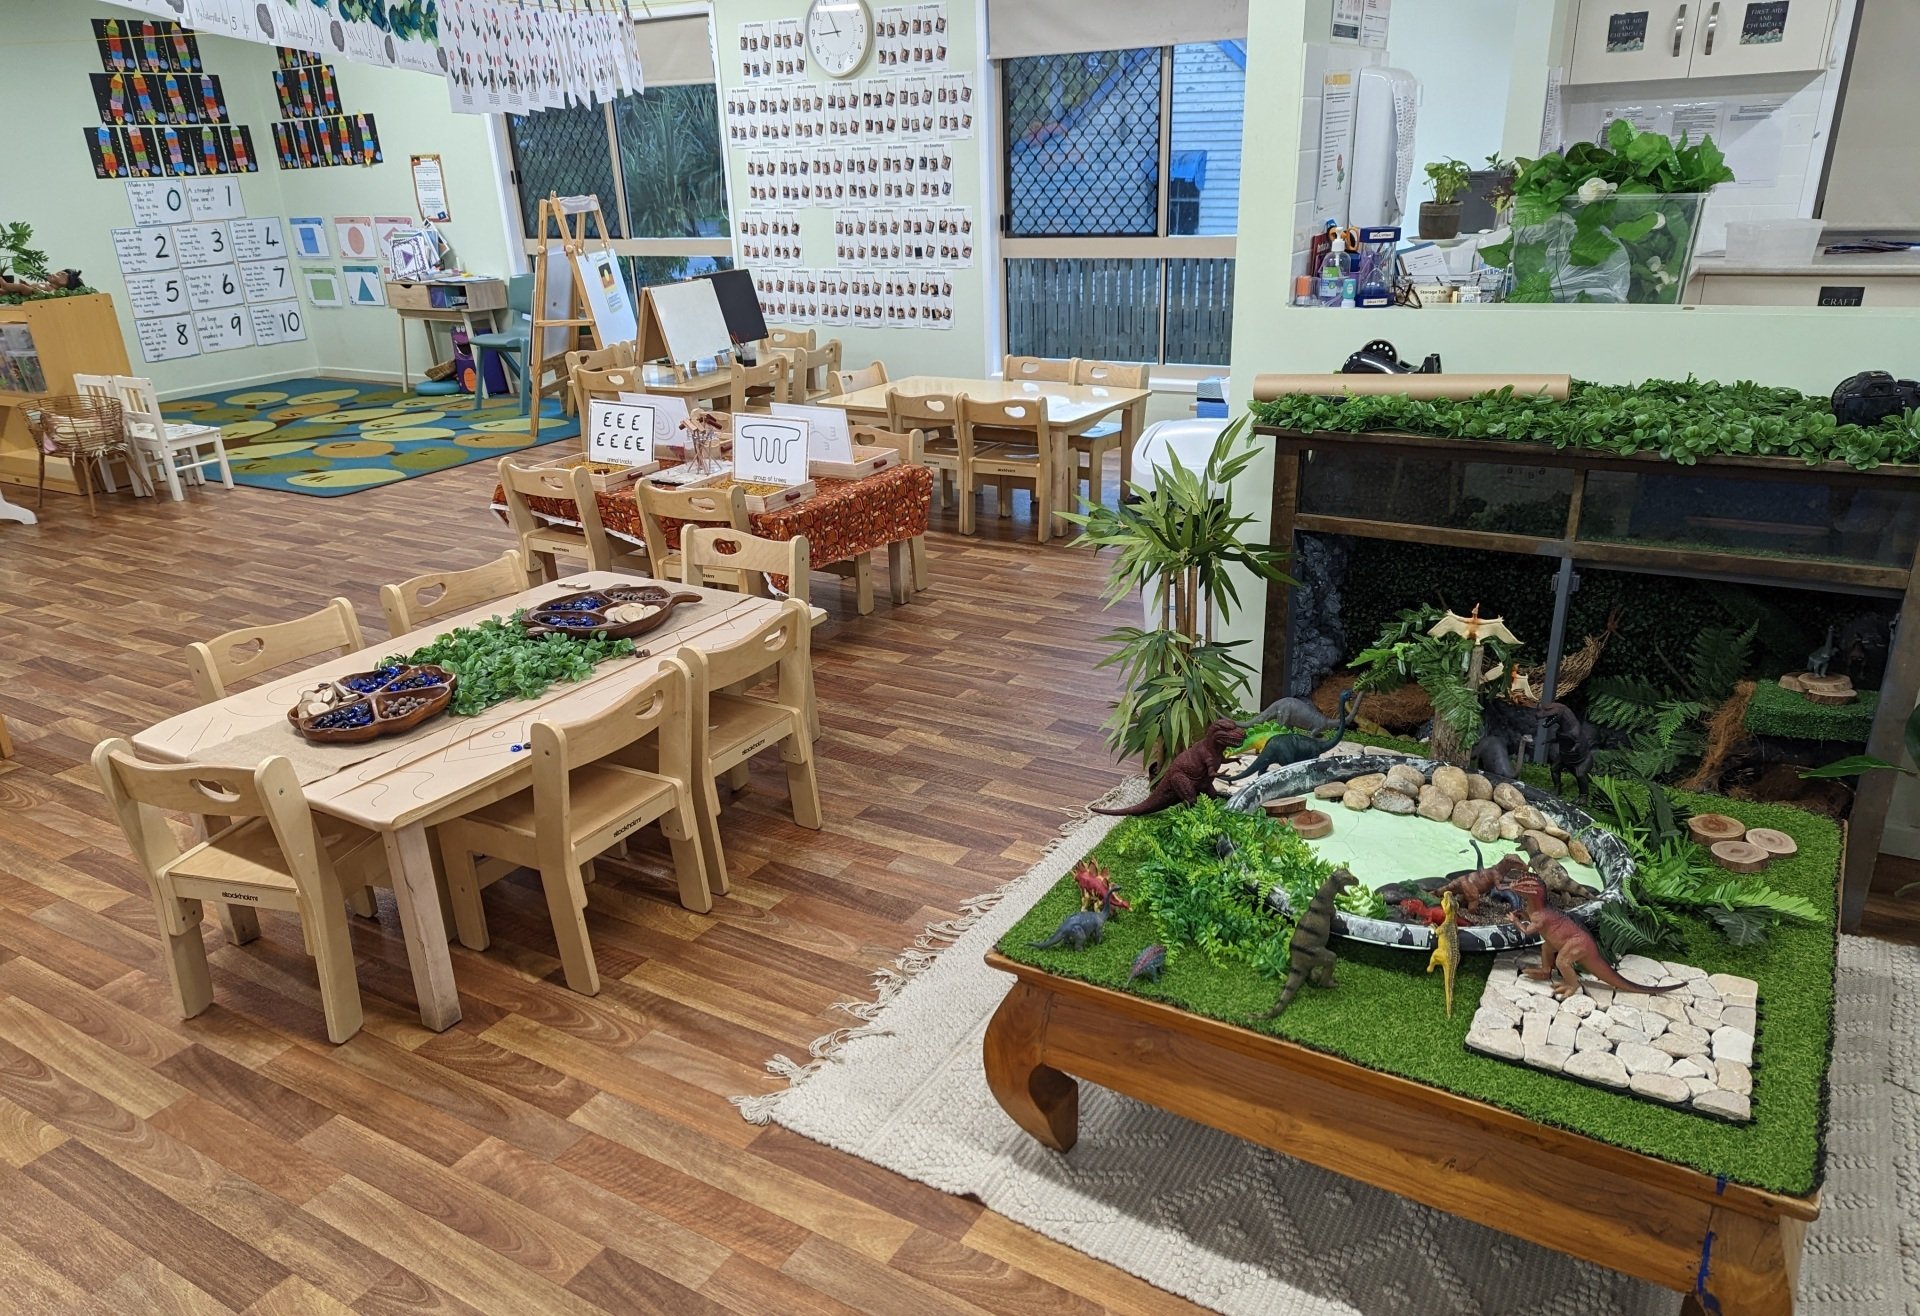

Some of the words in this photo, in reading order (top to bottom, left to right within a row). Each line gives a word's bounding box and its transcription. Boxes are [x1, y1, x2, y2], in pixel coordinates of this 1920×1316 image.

[232, 16, 238, 30] 5
[812, 12, 820, 20] 10
[812, 29, 816, 38] 9
[860, 24, 864, 32] 3
[816, 46, 820, 54] 8
[858, 42, 862, 50] 4
[826, 57, 830, 65] 7
[838, 60, 842, 69] 6
[849, 55, 854, 64] 5
[167, 190, 181, 212] 0
[226, 185, 232, 207] 1
[211, 230, 224, 252] 3
[266, 226, 279, 246] 4
[154, 235, 170, 258] 2
[222, 274, 234, 295] 6
[272, 268, 284, 288] 7
[166, 280, 179, 302] 5
[1822, 298, 1858, 306] CRAFT
[231, 316, 242, 336] 9
[281, 312, 300, 333] 10
[176, 324, 188, 345] 8
